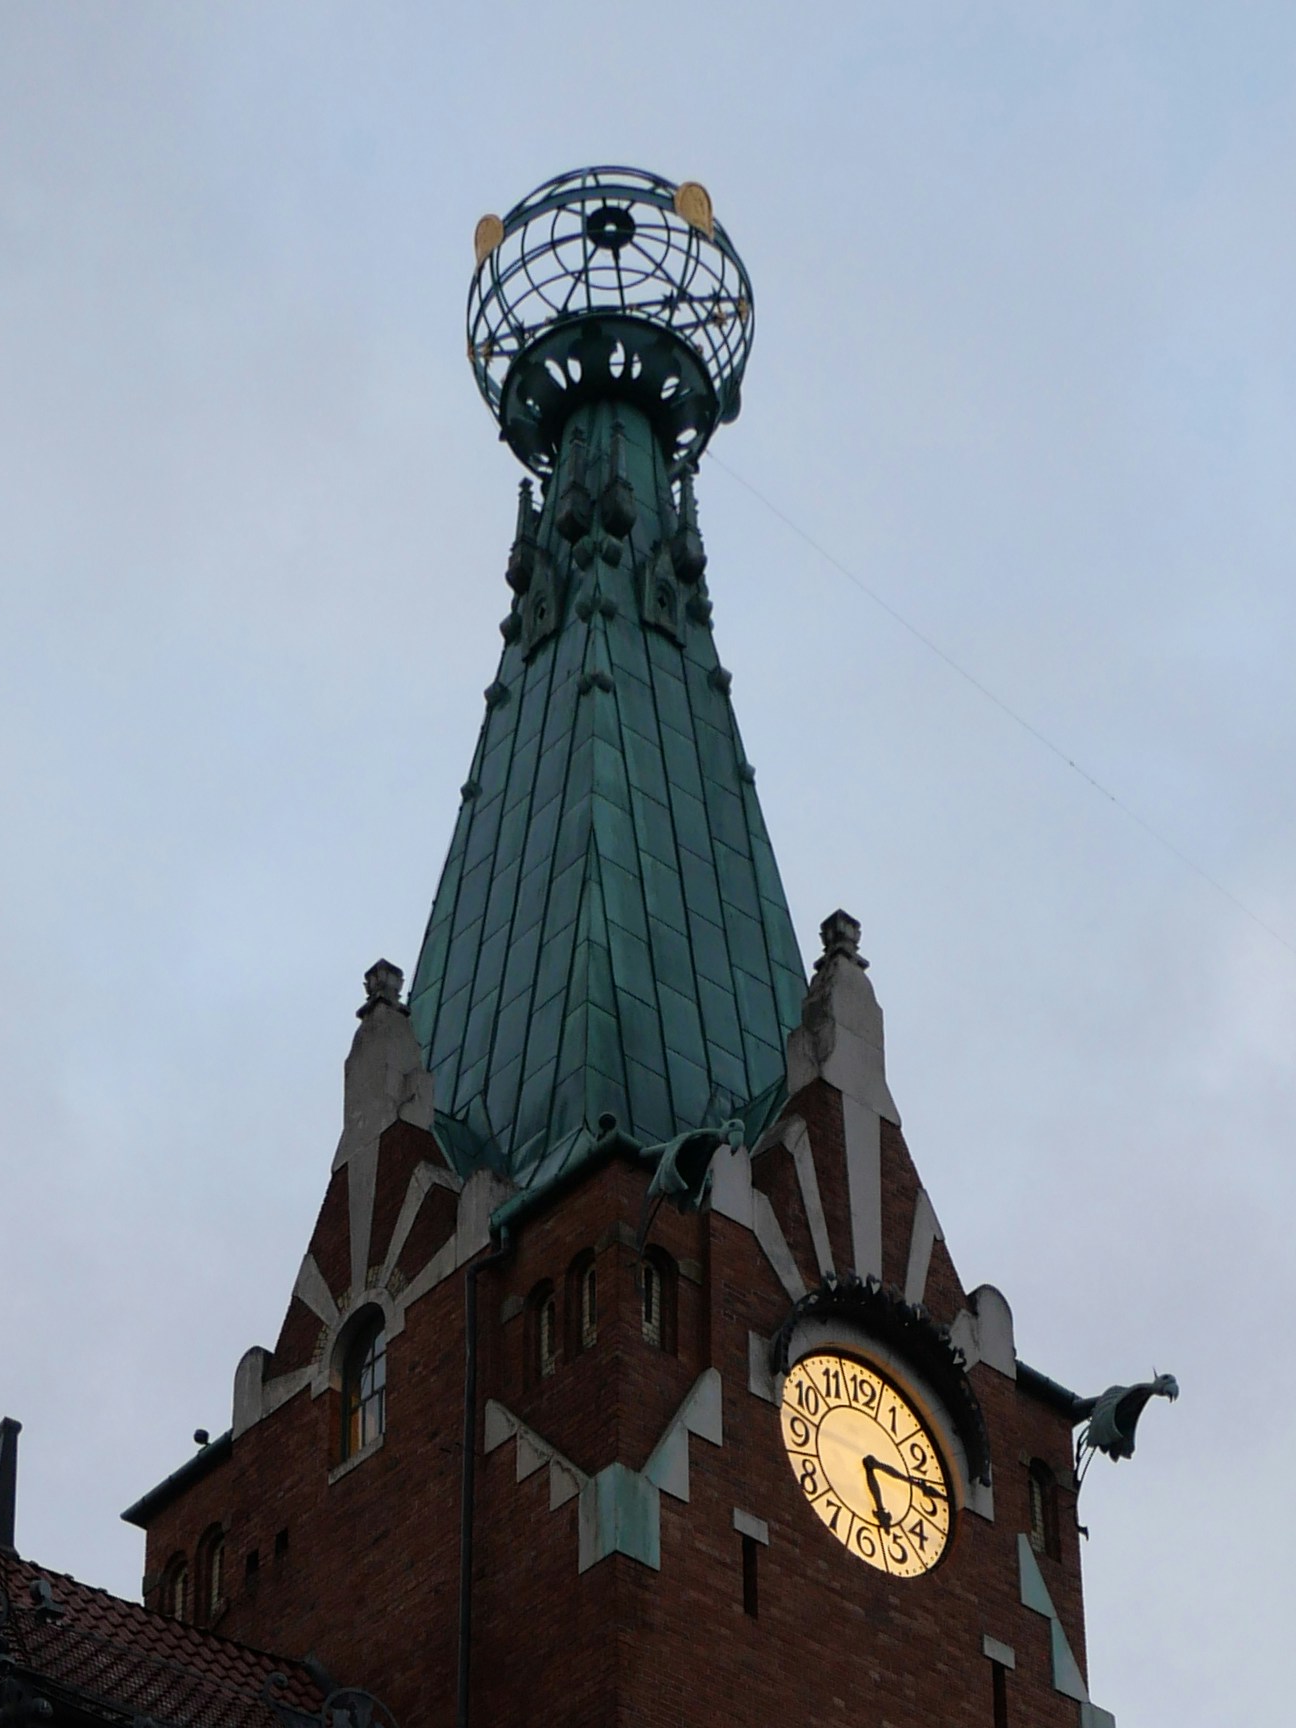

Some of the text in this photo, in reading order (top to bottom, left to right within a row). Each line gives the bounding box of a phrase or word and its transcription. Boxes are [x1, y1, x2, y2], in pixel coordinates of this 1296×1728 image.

[795, 1380, 820, 1416] 10
[822, 1367, 842, 1399] 11
[850, 1373, 877, 1411] 12
[790, 1416, 810, 1448] 9
[888, 1406, 898, 1437] 1
[909, 1443, 929, 1476] 2
[800, 1460, 817, 1495] 8
[826, 1500, 842, 1534] 7
[856, 1526, 876, 1558] 6
[886, 1534, 908, 1564] 5
[908, 1518, 929, 1552] 4
